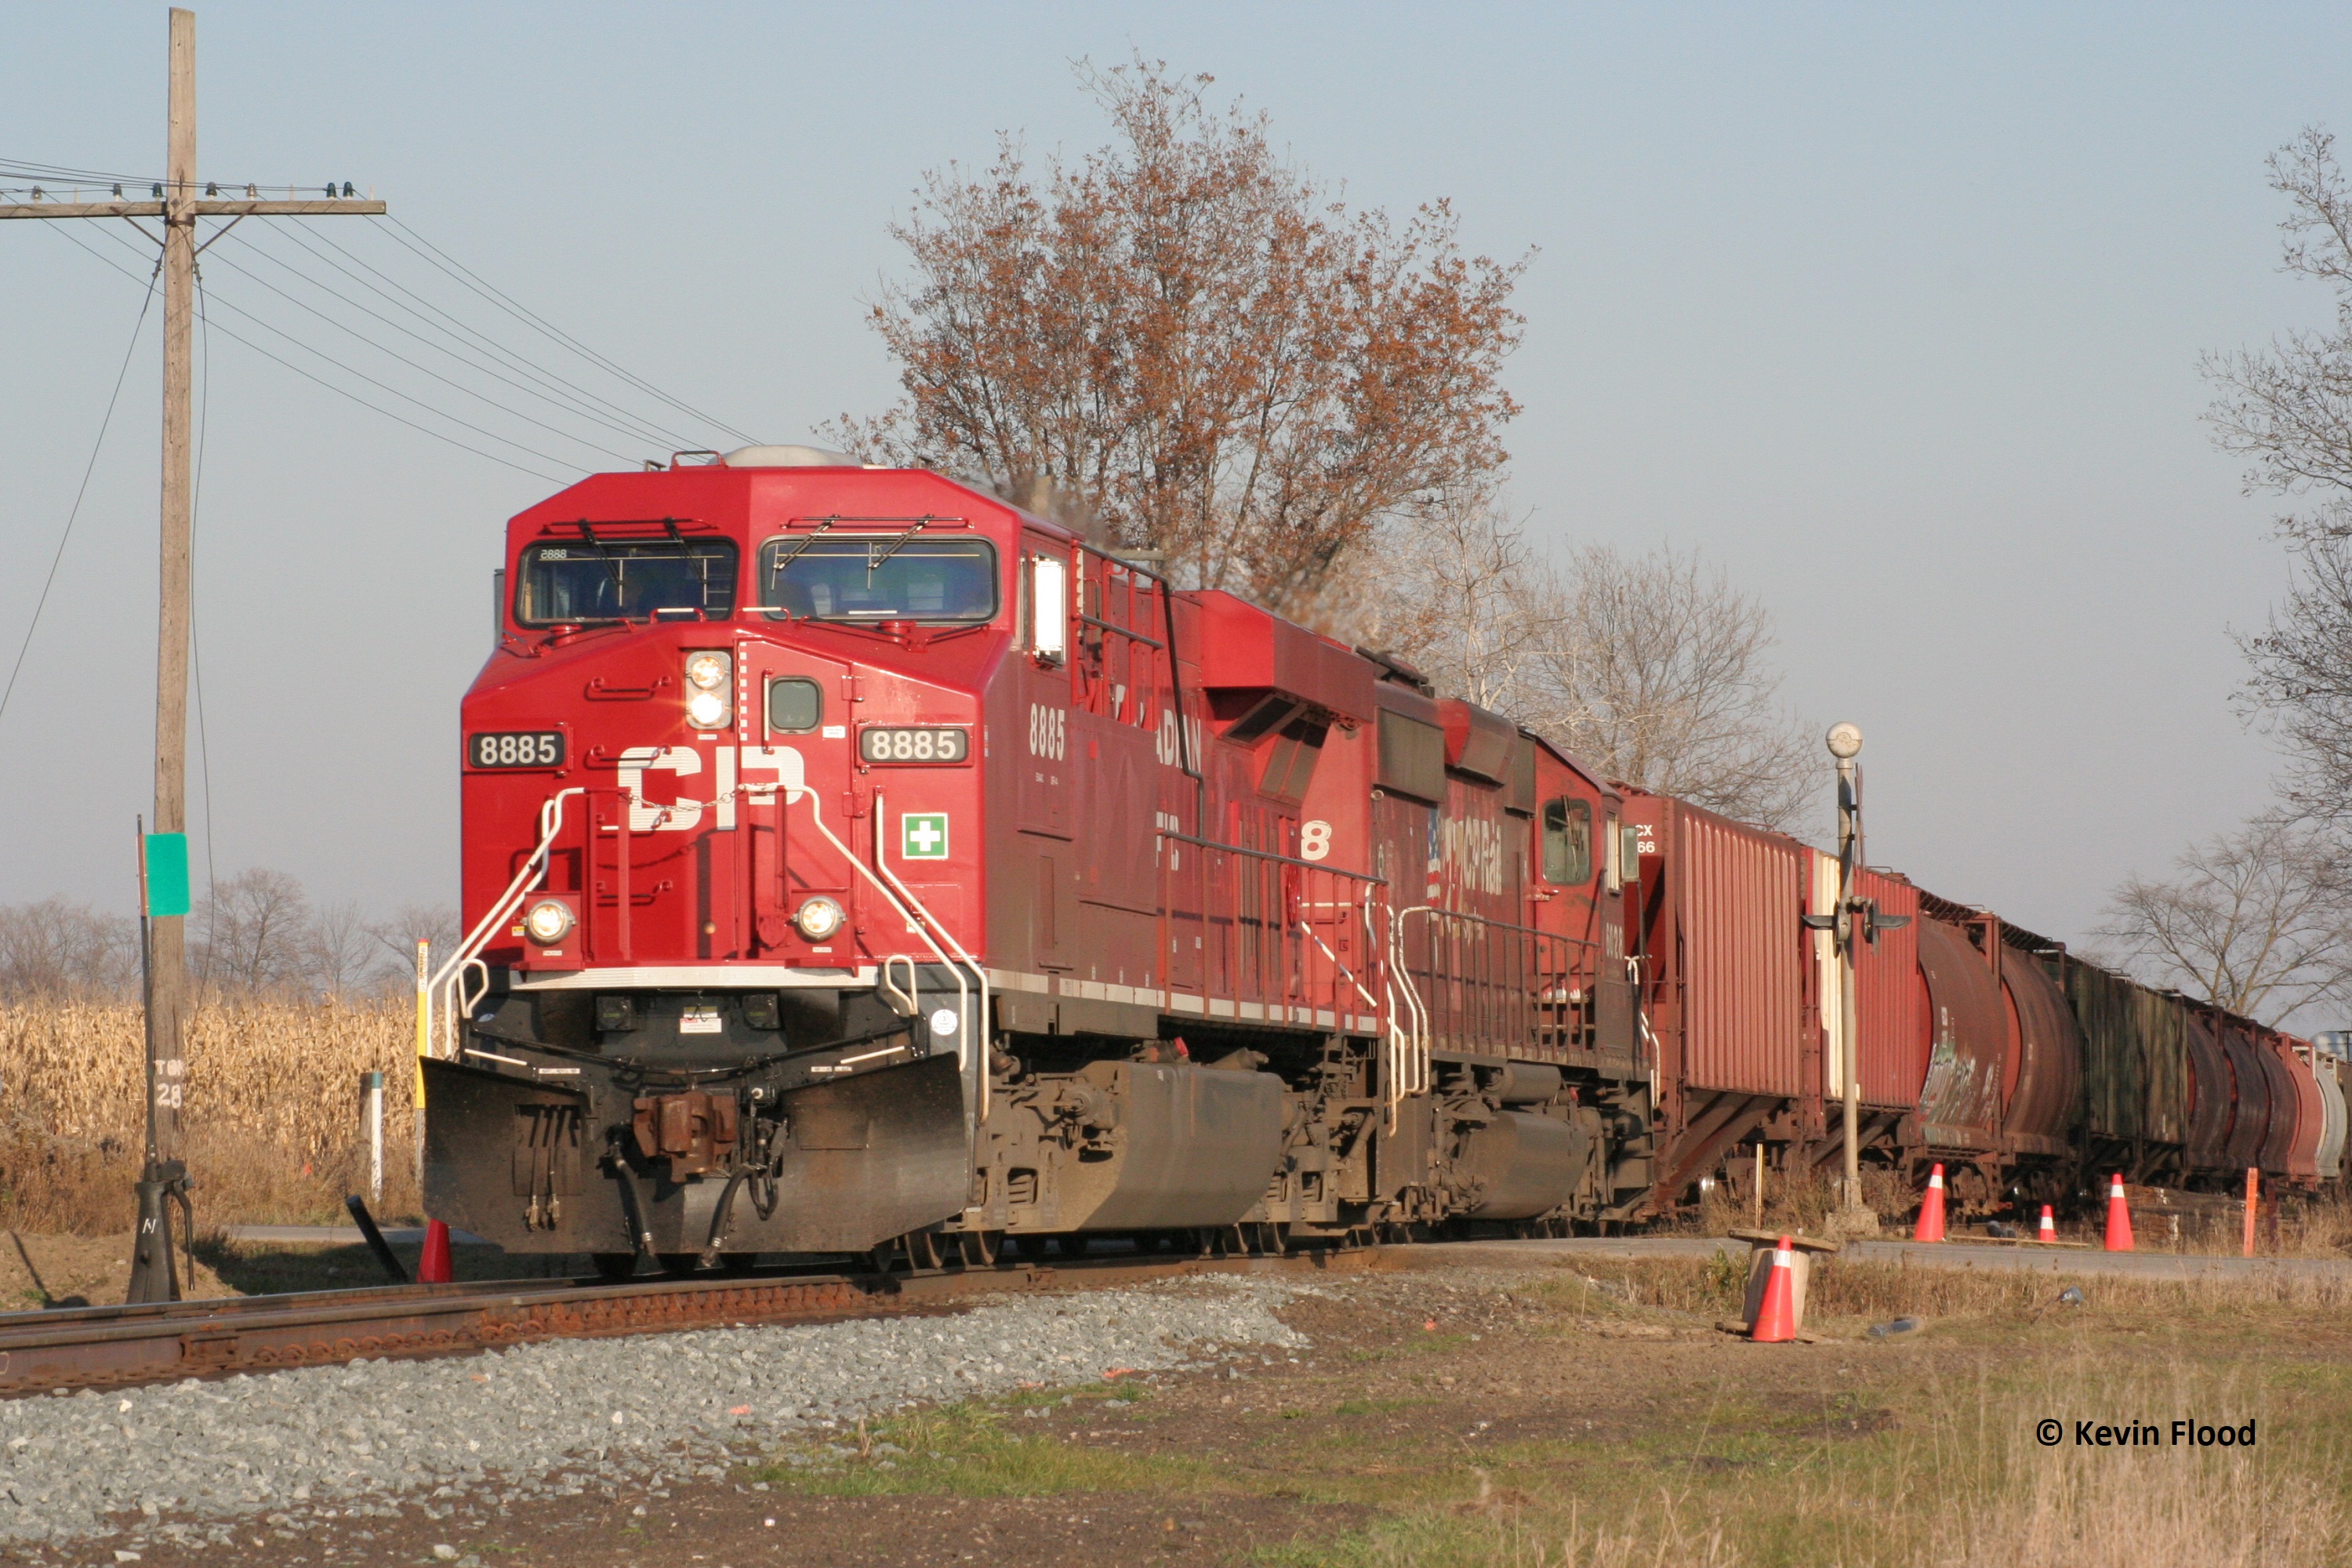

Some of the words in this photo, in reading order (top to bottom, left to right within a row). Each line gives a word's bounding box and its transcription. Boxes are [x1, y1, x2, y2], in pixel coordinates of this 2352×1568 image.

[872, 731, 956, 760] 8885
[1029, 702, 1065, 761] 8885
[480, 735, 556, 764] 8885
[618, 746, 804, 831] CP
[157, 1083, 181, 1109] 28
